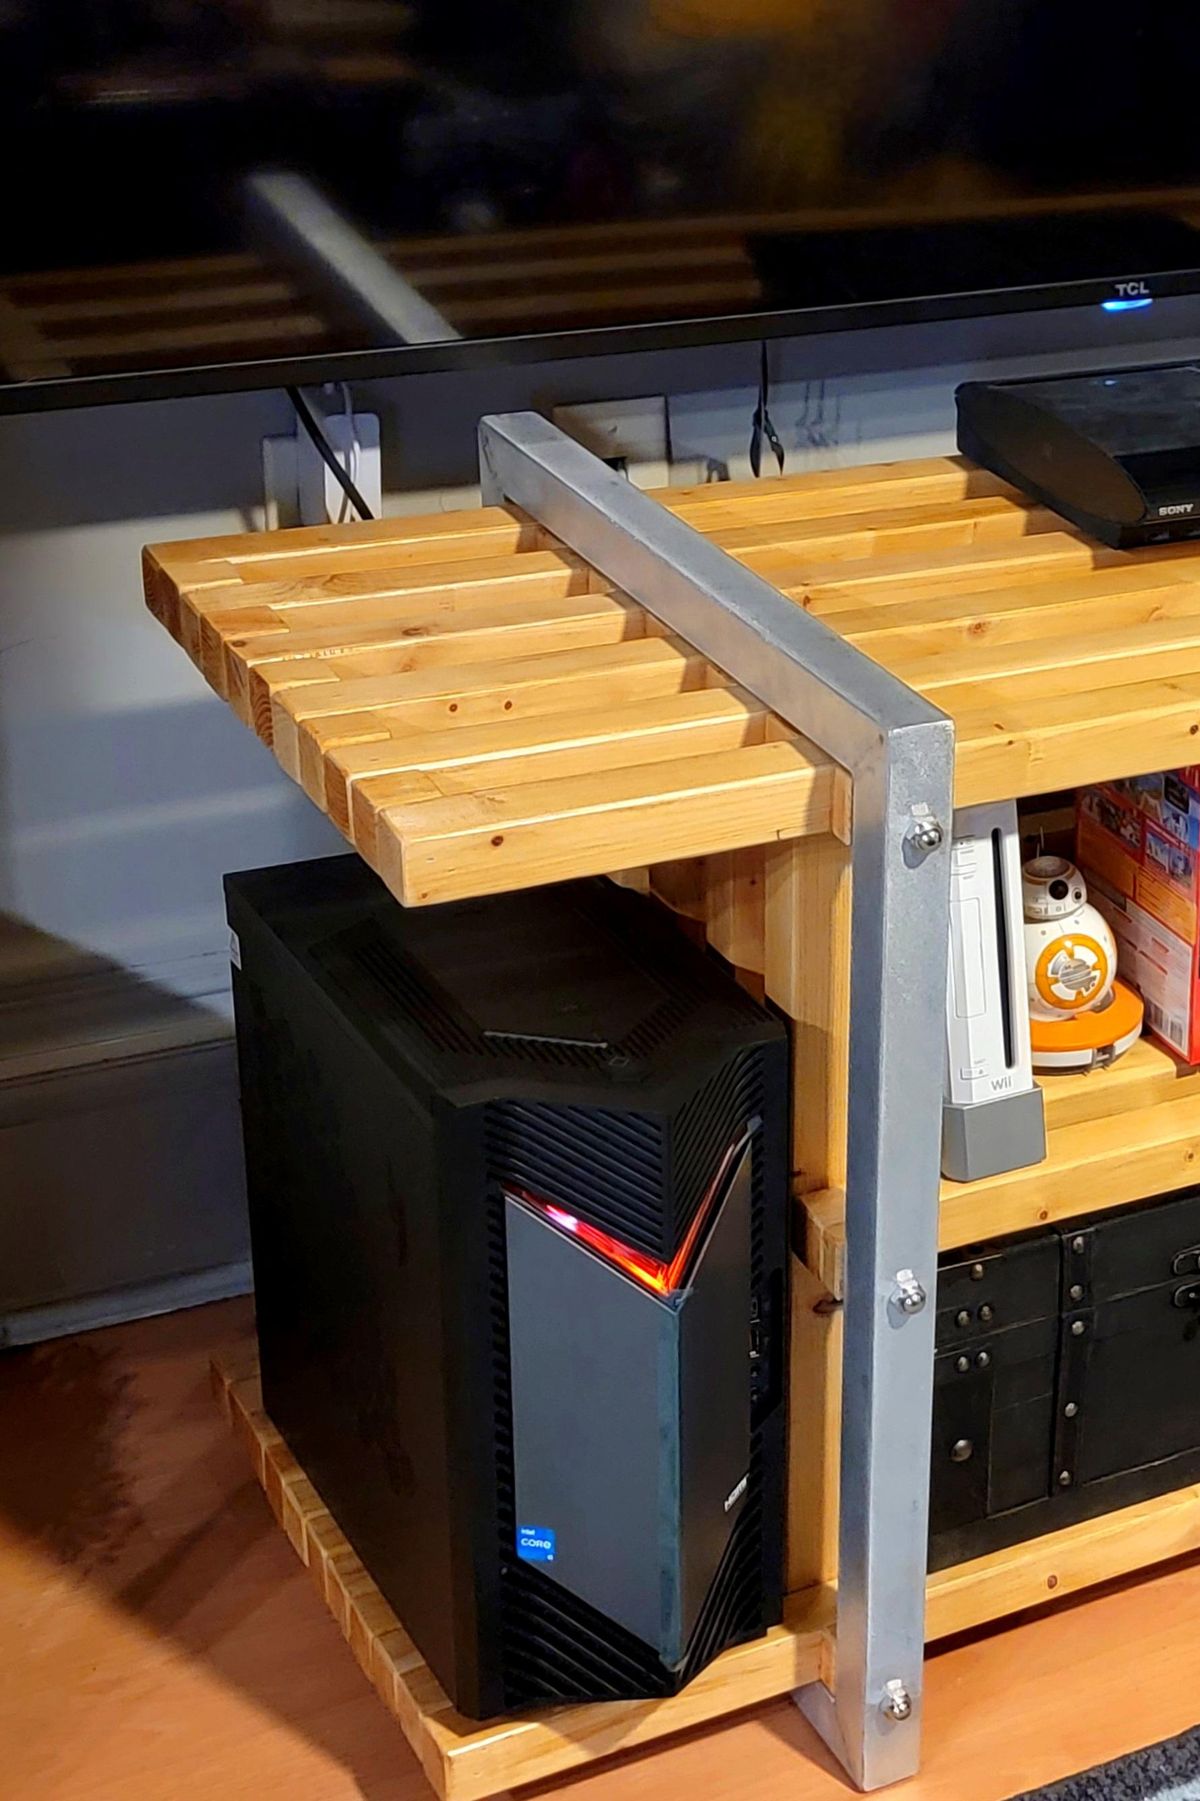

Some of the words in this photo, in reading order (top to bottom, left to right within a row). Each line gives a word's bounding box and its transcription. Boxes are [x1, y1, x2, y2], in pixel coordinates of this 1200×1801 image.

[1115, 281, 1150, 297] TCL
[1158, 503, 1194, 516] SONY
[991, 1075, 1012, 1091] Wii
